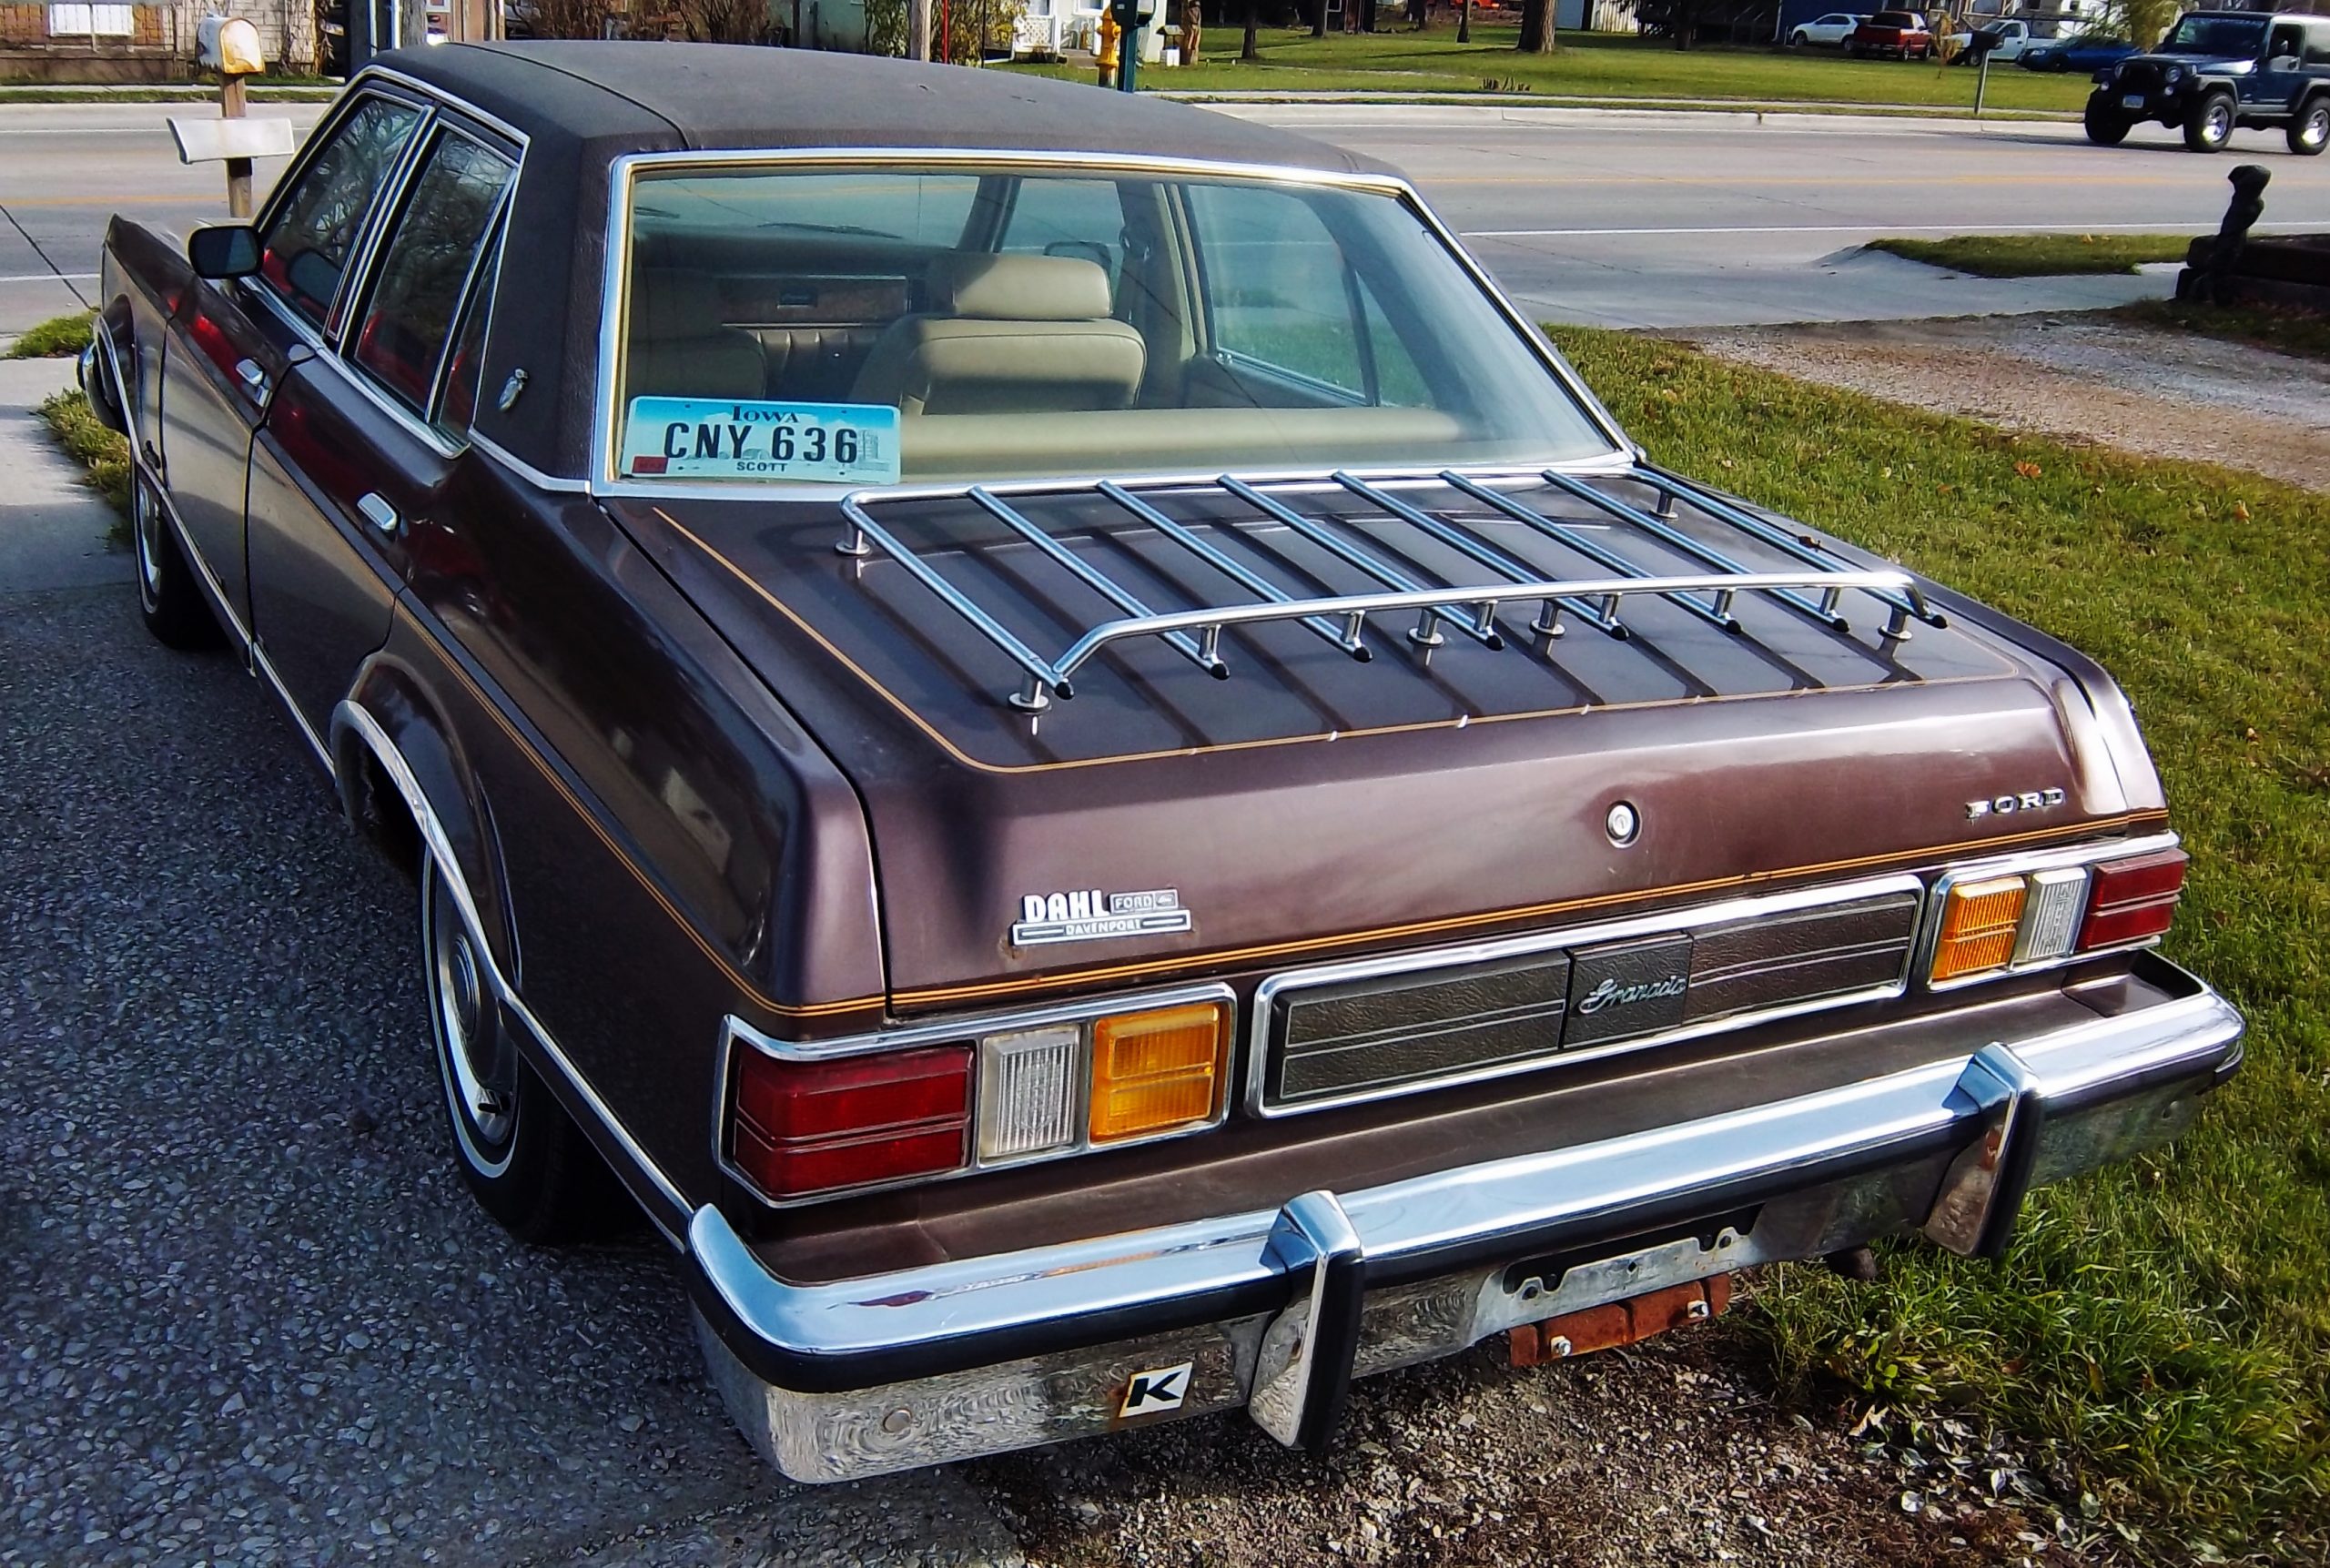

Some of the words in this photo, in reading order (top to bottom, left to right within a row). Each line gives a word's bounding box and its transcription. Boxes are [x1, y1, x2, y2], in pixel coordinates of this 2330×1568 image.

[664, 422, 752, 460] CNY
[771, 426, 857, 464] 636
[736, 460, 788, 472] SCOTT
[1966, 788, 2065, 819] FORD
[1023, 889, 1110, 924] DAHL
[1115, 895, 1153, 910] FORD
[1066, 918, 1141, 936] DAVENPORT
[1578, 975, 1687, 1015] Granada
[1126, 1370, 1184, 1408] K
